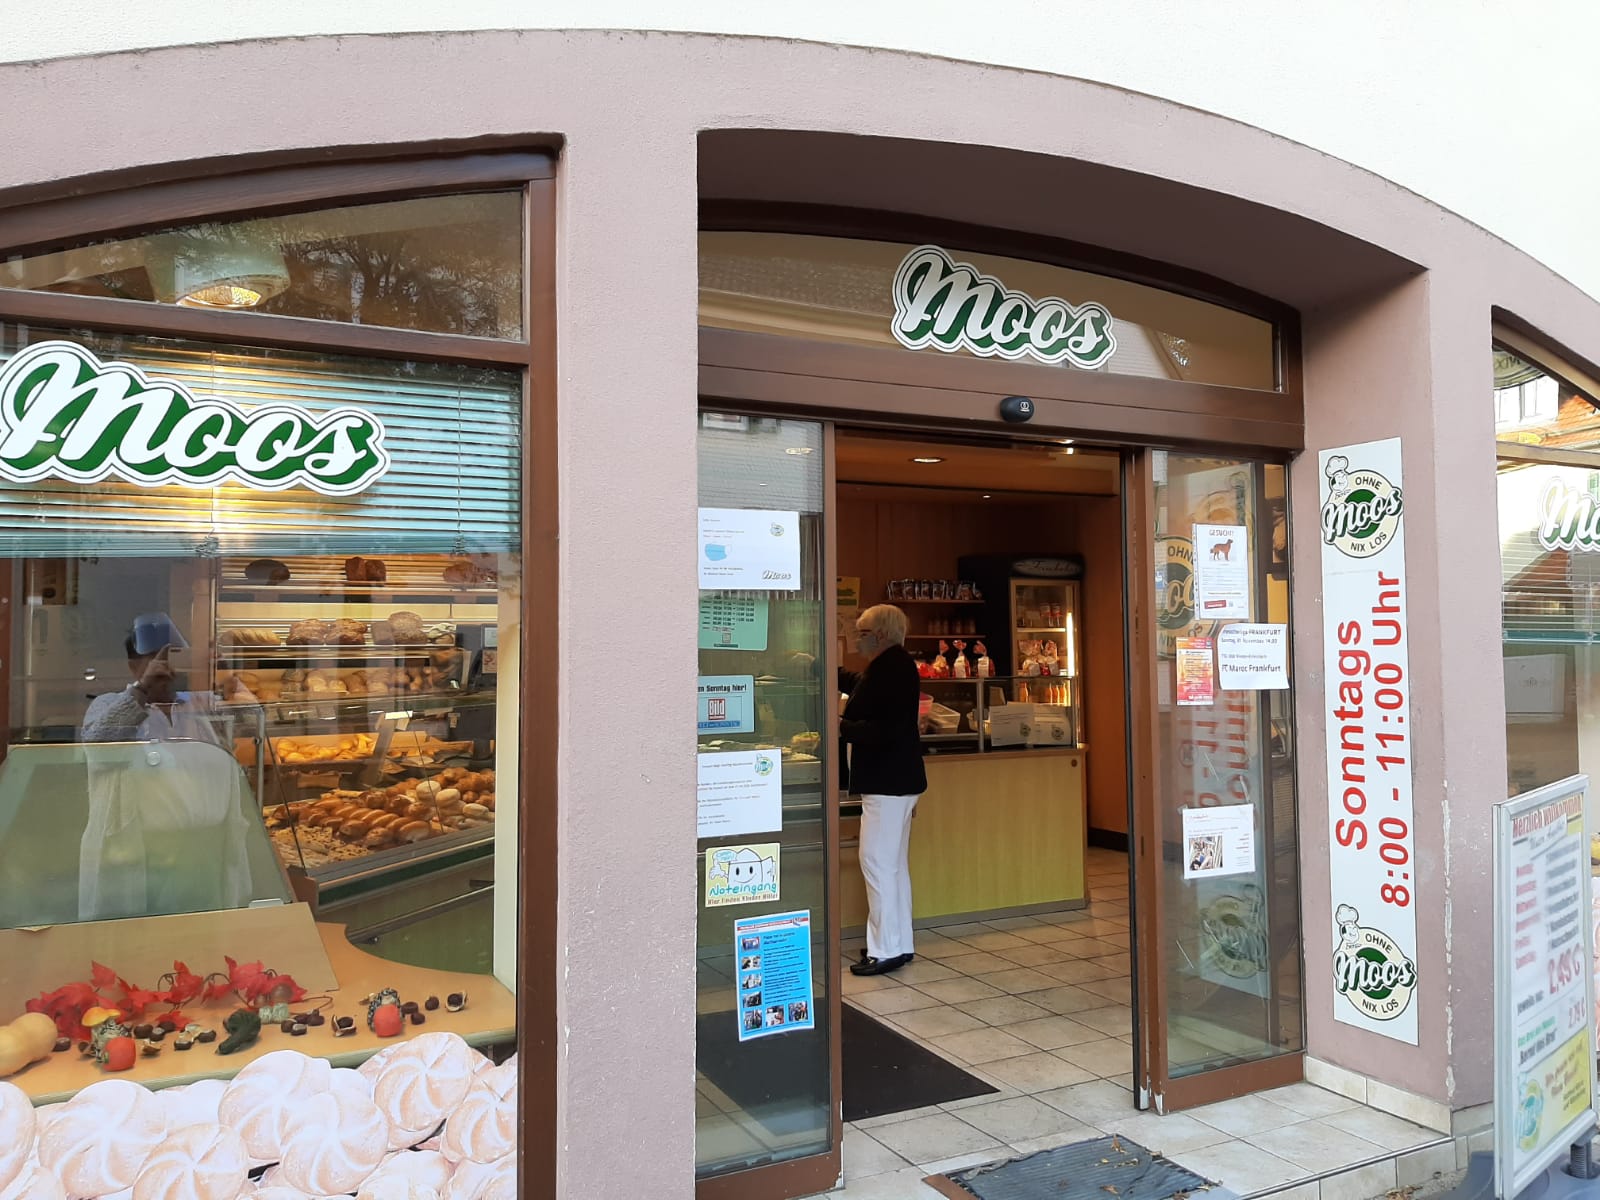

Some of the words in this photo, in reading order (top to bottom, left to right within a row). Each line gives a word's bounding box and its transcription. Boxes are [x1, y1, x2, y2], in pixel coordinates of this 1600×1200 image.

[903, 253, 1113, 361] Moos
[0, 350, 378, 488] Moos
[1355, 476, 1382, 490] OHNE
[1324, 489, 1403, 543] Moos
[1167, 545, 1194, 564] OHN
[1350, 541, 1366, 552] NIX
[1369, 531, 1387, 549] LOS
[1371, 571, 1402, 646] Uhr
[1249, 663, 1281, 673] Frankfurt
[706, 685, 731, 693] Sonntag
[1373, 663, 1406, 771] 11:00
[1334, 619, 1371, 850] Sonntags
[1379, 817, 1410, 907] 8:00
[709, 882, 777, 896] Noteingang
[1365, 933, 1393, 954] OHNE
[1336, 952, 1416, 993] Moos
[1362, 999, 1378, 1013] NIX
[1381, 998, 1399, 1014] LOS
